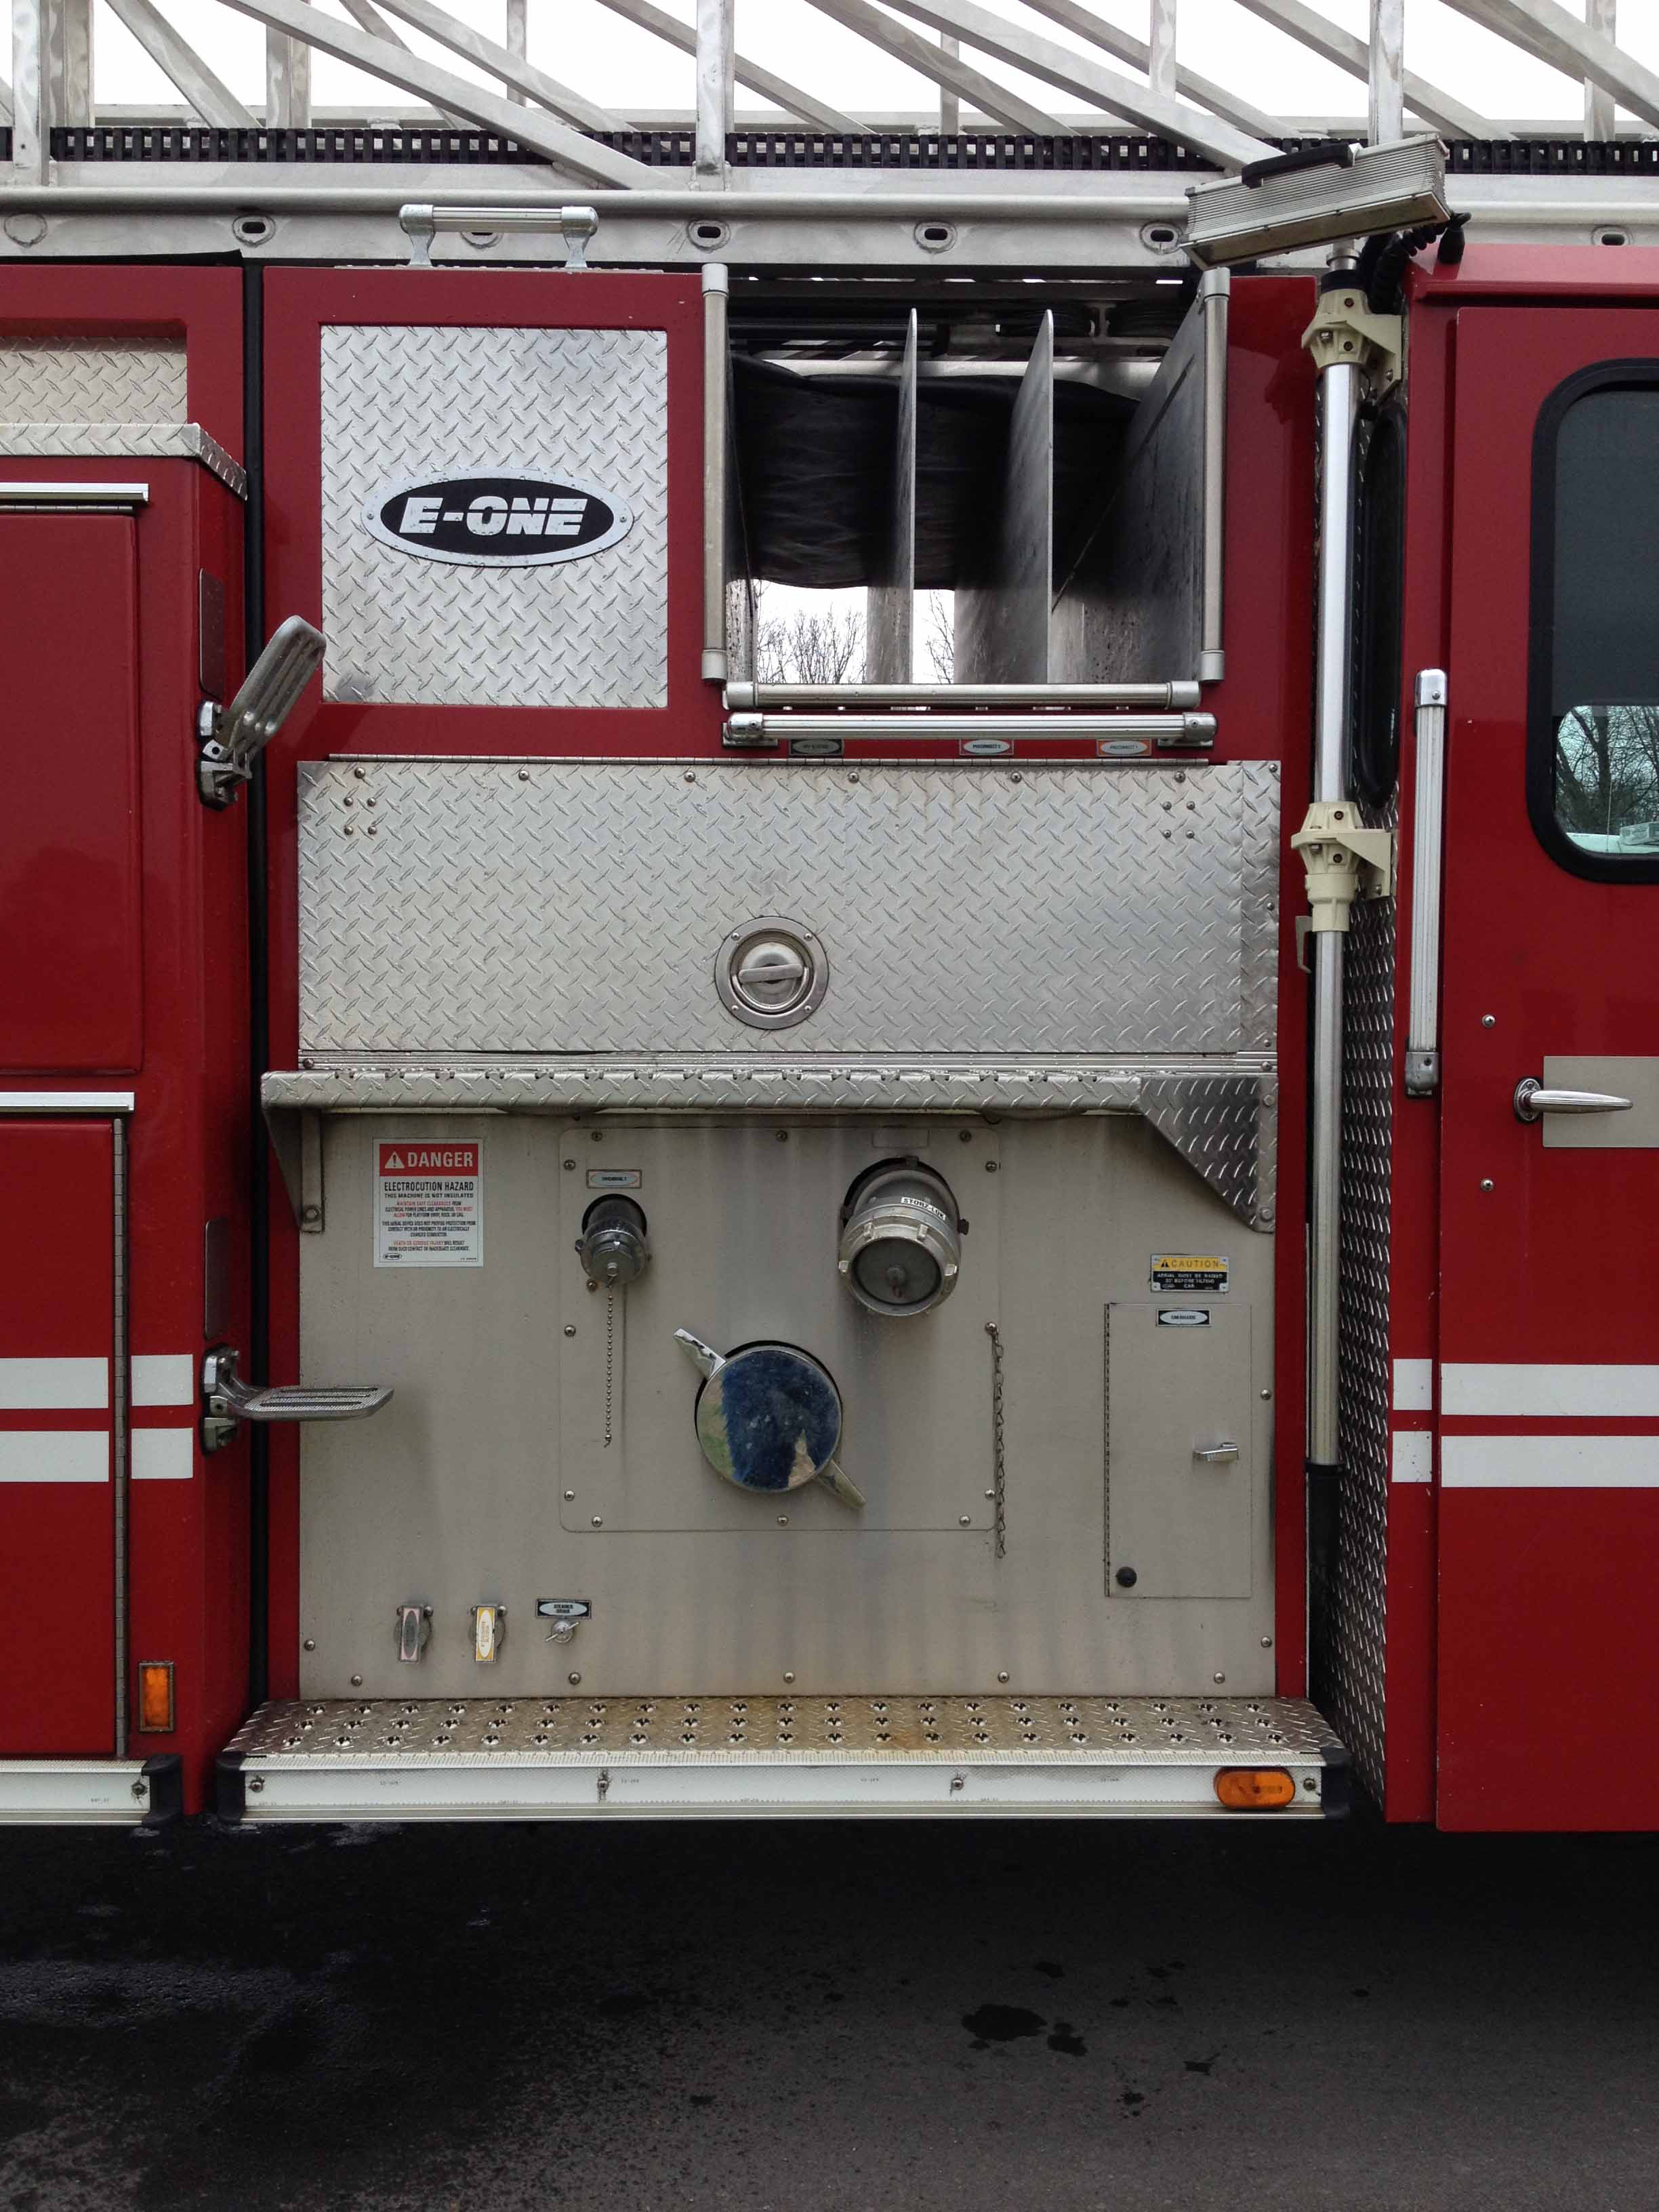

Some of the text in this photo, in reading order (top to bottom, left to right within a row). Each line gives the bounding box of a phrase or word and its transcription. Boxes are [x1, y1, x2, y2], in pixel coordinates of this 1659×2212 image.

[399, 496, 588, 535] E-ONE
[407, 1151, 474, 1168] DANGER
[384, 1181, 474, 1191] ELECTROCUTION HAZARD
[1171, 1259, 1219, 1268] CAUTION
